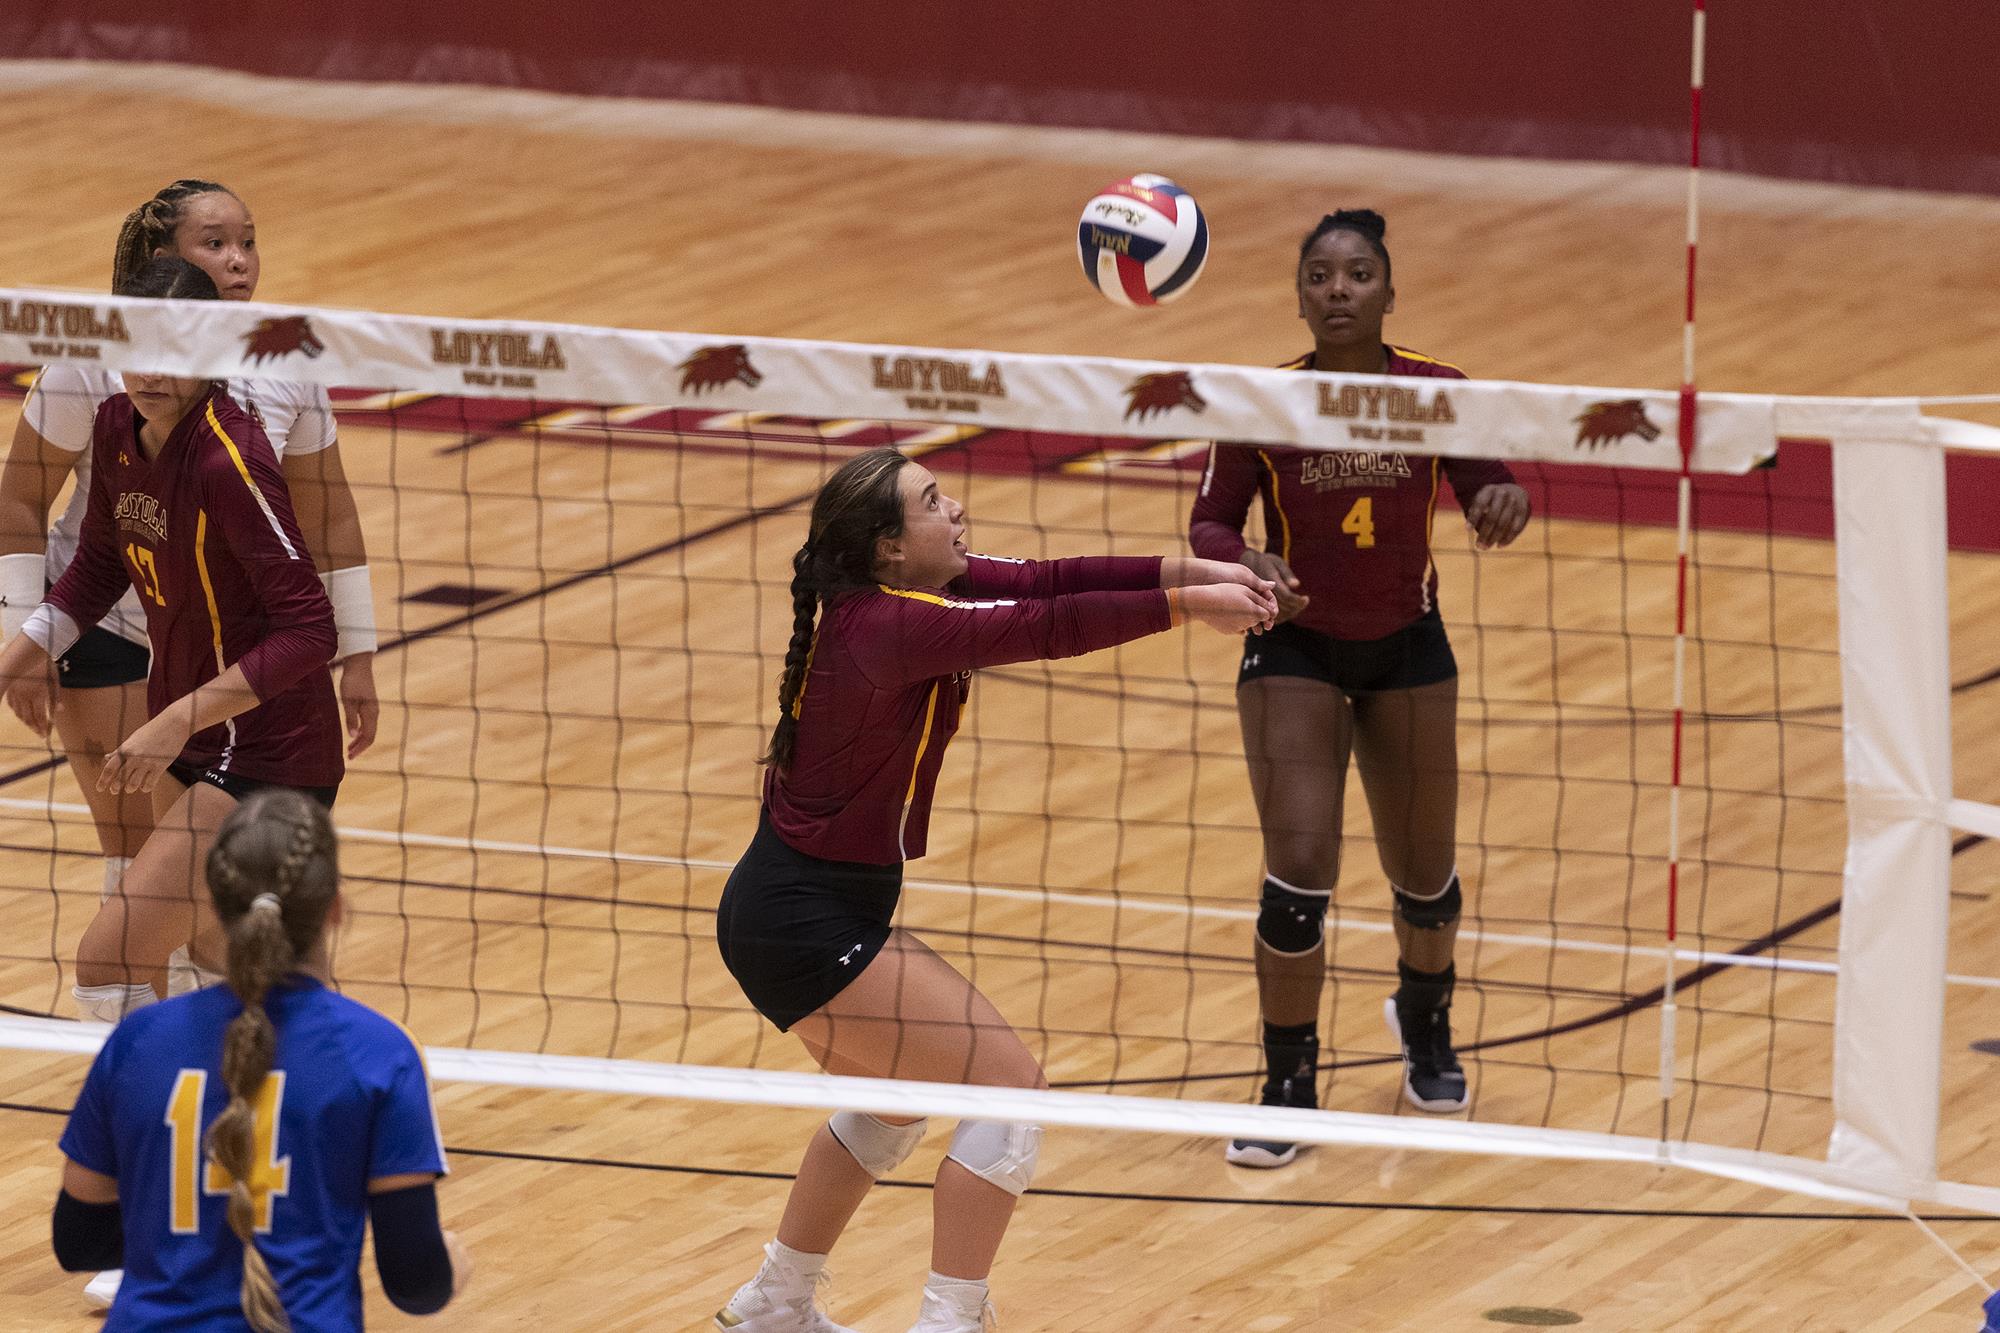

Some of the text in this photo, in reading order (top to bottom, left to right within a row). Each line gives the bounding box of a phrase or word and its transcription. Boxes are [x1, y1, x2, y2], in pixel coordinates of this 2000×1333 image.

[0, 301, 130, 343] LOYOLA
[430, 328, 566, 371] LOYOLA
[871, 355, 1005, 397] LOYOLA
[1317, 382, 1457, 425] LOYOLA
[1301, 450, 1412, 484] LOYOLA
[114, 492, 168, 541] LOYOLA
[1341, 497, 1376, 549] 4
[164, 1067, 292, 1236] 14
